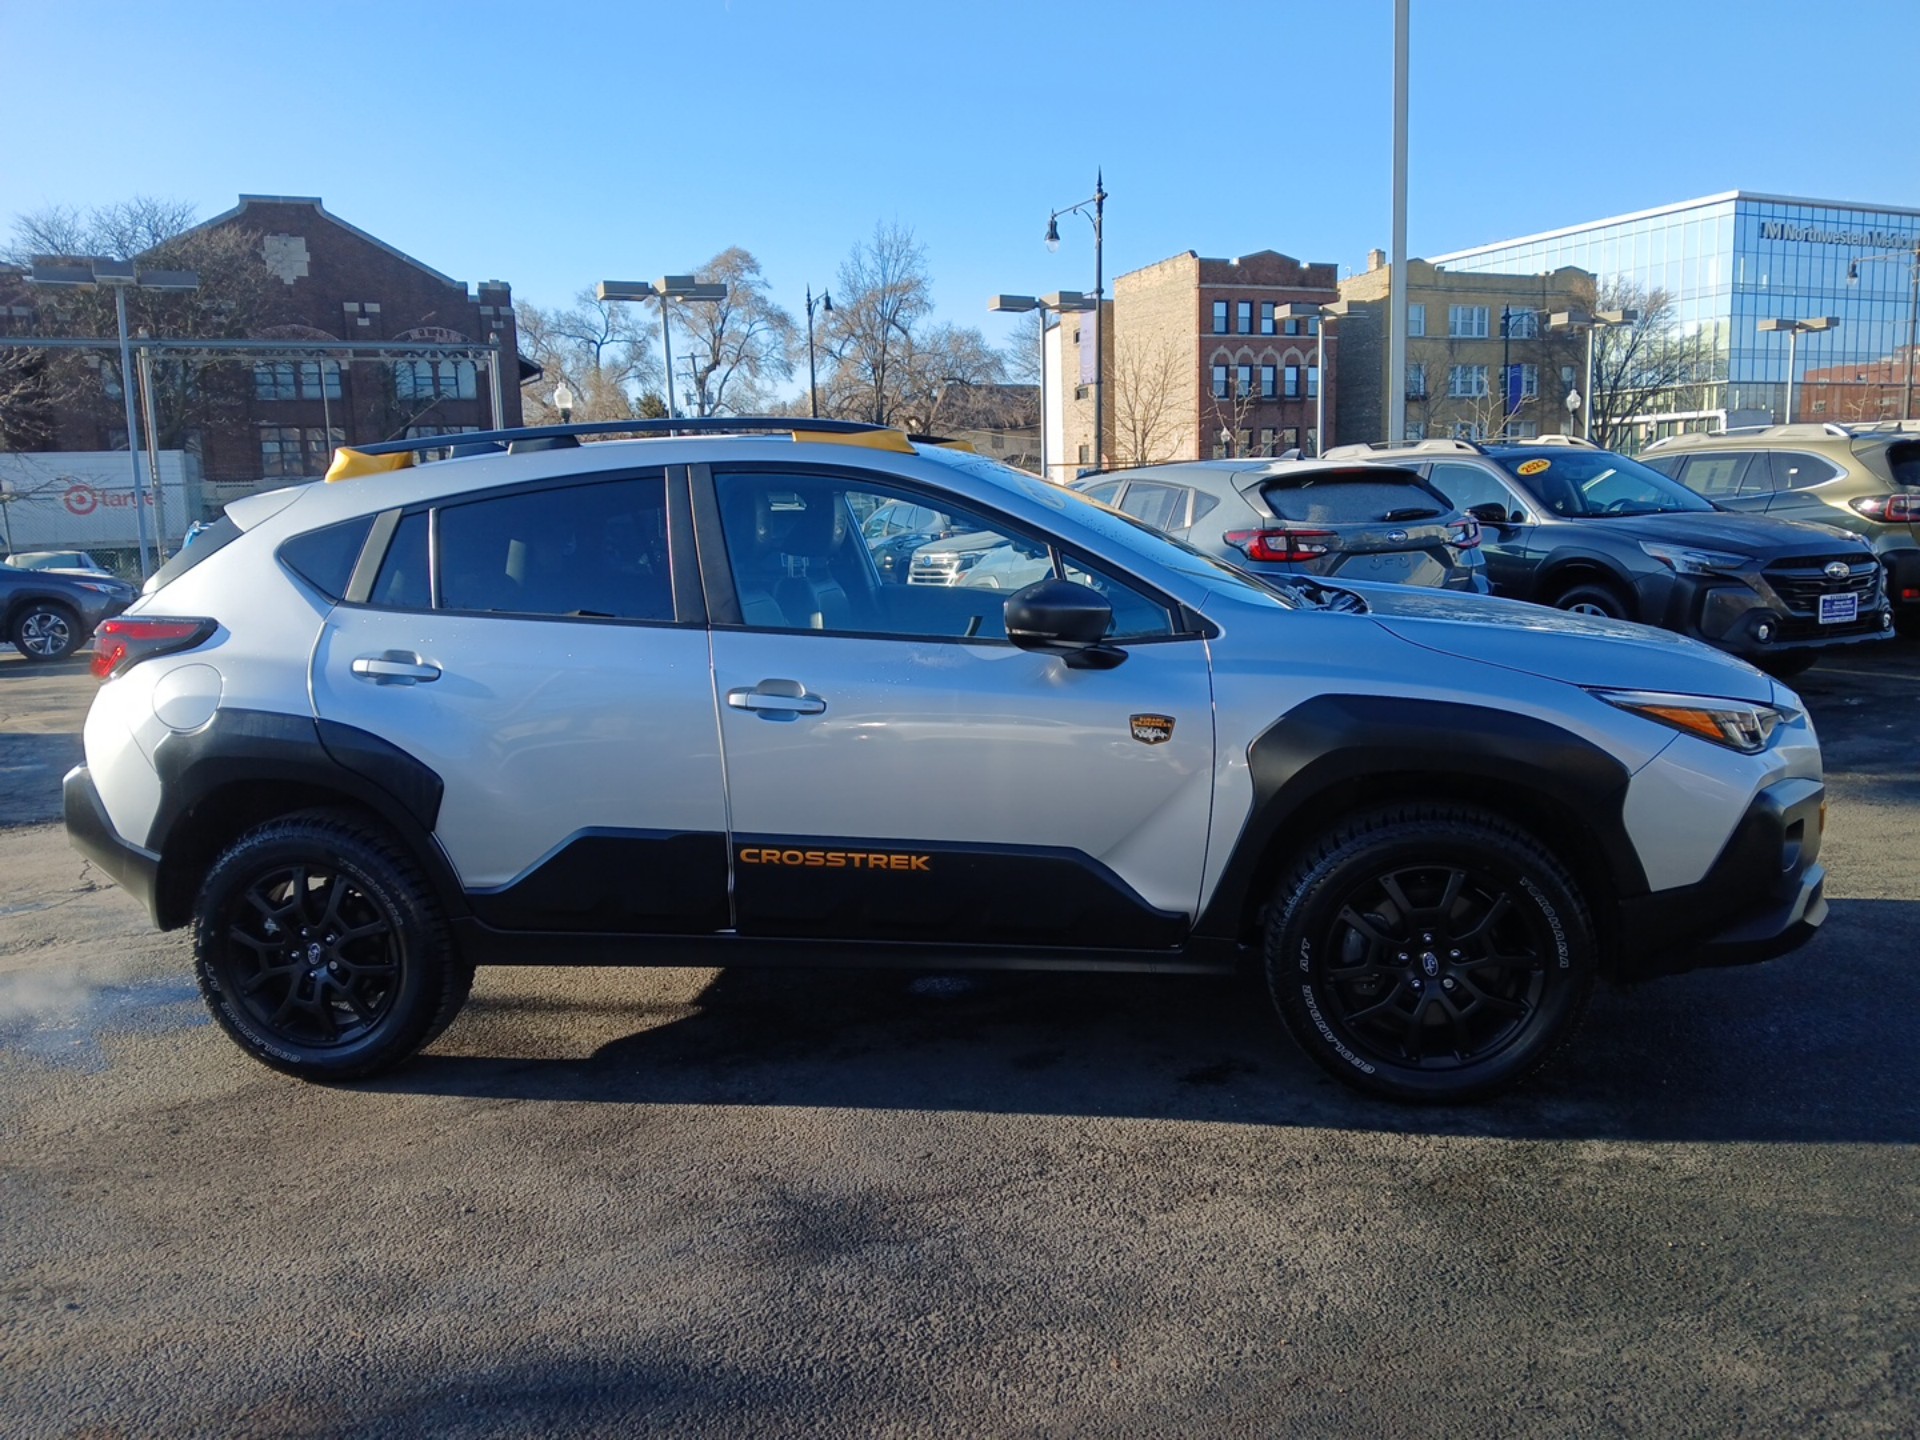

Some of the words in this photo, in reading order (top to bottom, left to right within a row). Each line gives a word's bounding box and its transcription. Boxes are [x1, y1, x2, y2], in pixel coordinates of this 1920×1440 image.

[1785, 223, 1871, 247] Northwestern
[1872, 231, 1919, 250] Medicin
[102, 489, 166, 509] targe
[740, 848, 931, 871] CROSSTREK
[1519, 876, 1570, 969] YOKOHAMA
[1299, 937, 1311, 973] A/T
[204, 961, 221, 992] A/T
[220, 1001, 302, 1063] GEOLANDAR
[1302, 984, 1376, 1074] GEOLANDAR
